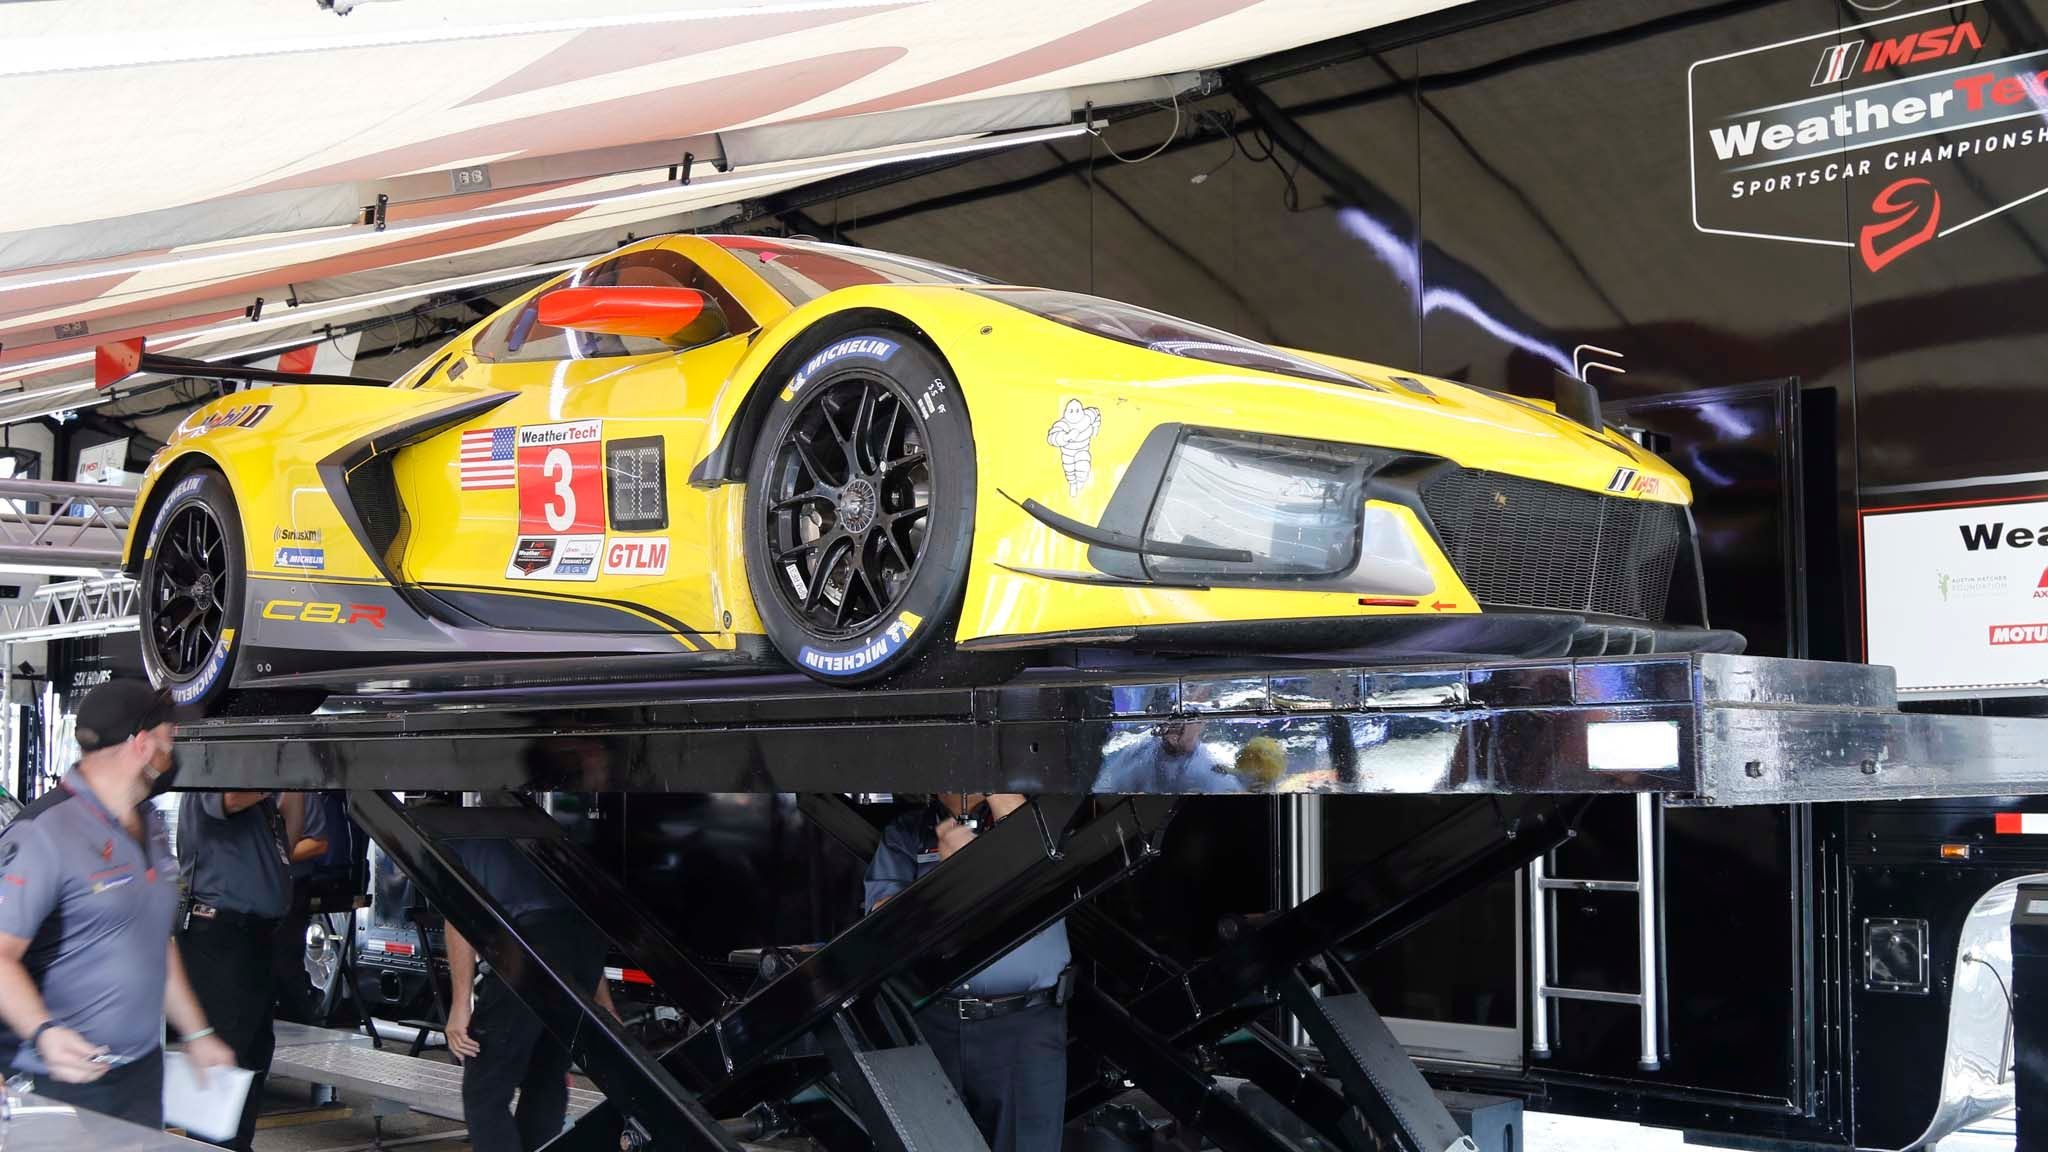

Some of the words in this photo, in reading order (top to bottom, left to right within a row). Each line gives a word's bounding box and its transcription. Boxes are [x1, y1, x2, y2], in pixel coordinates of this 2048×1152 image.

[1862, 21, 1982, 73] IMSA
[806, 339, 890, 375] MICHELIN
[521, 424, 598, 444] WeatherTech
[154, 477, 202, 530] MICHELIN
[543, 447, 577, 532] 3
[288, 555, 324, 565] MICHELIN
[608, 543, 668, 569] GTLM
[262, 599, 386, 631] C8.R
[806, 638, 888, 671] MICHELIN
[172, 659, 218, 703] MICHELIN
